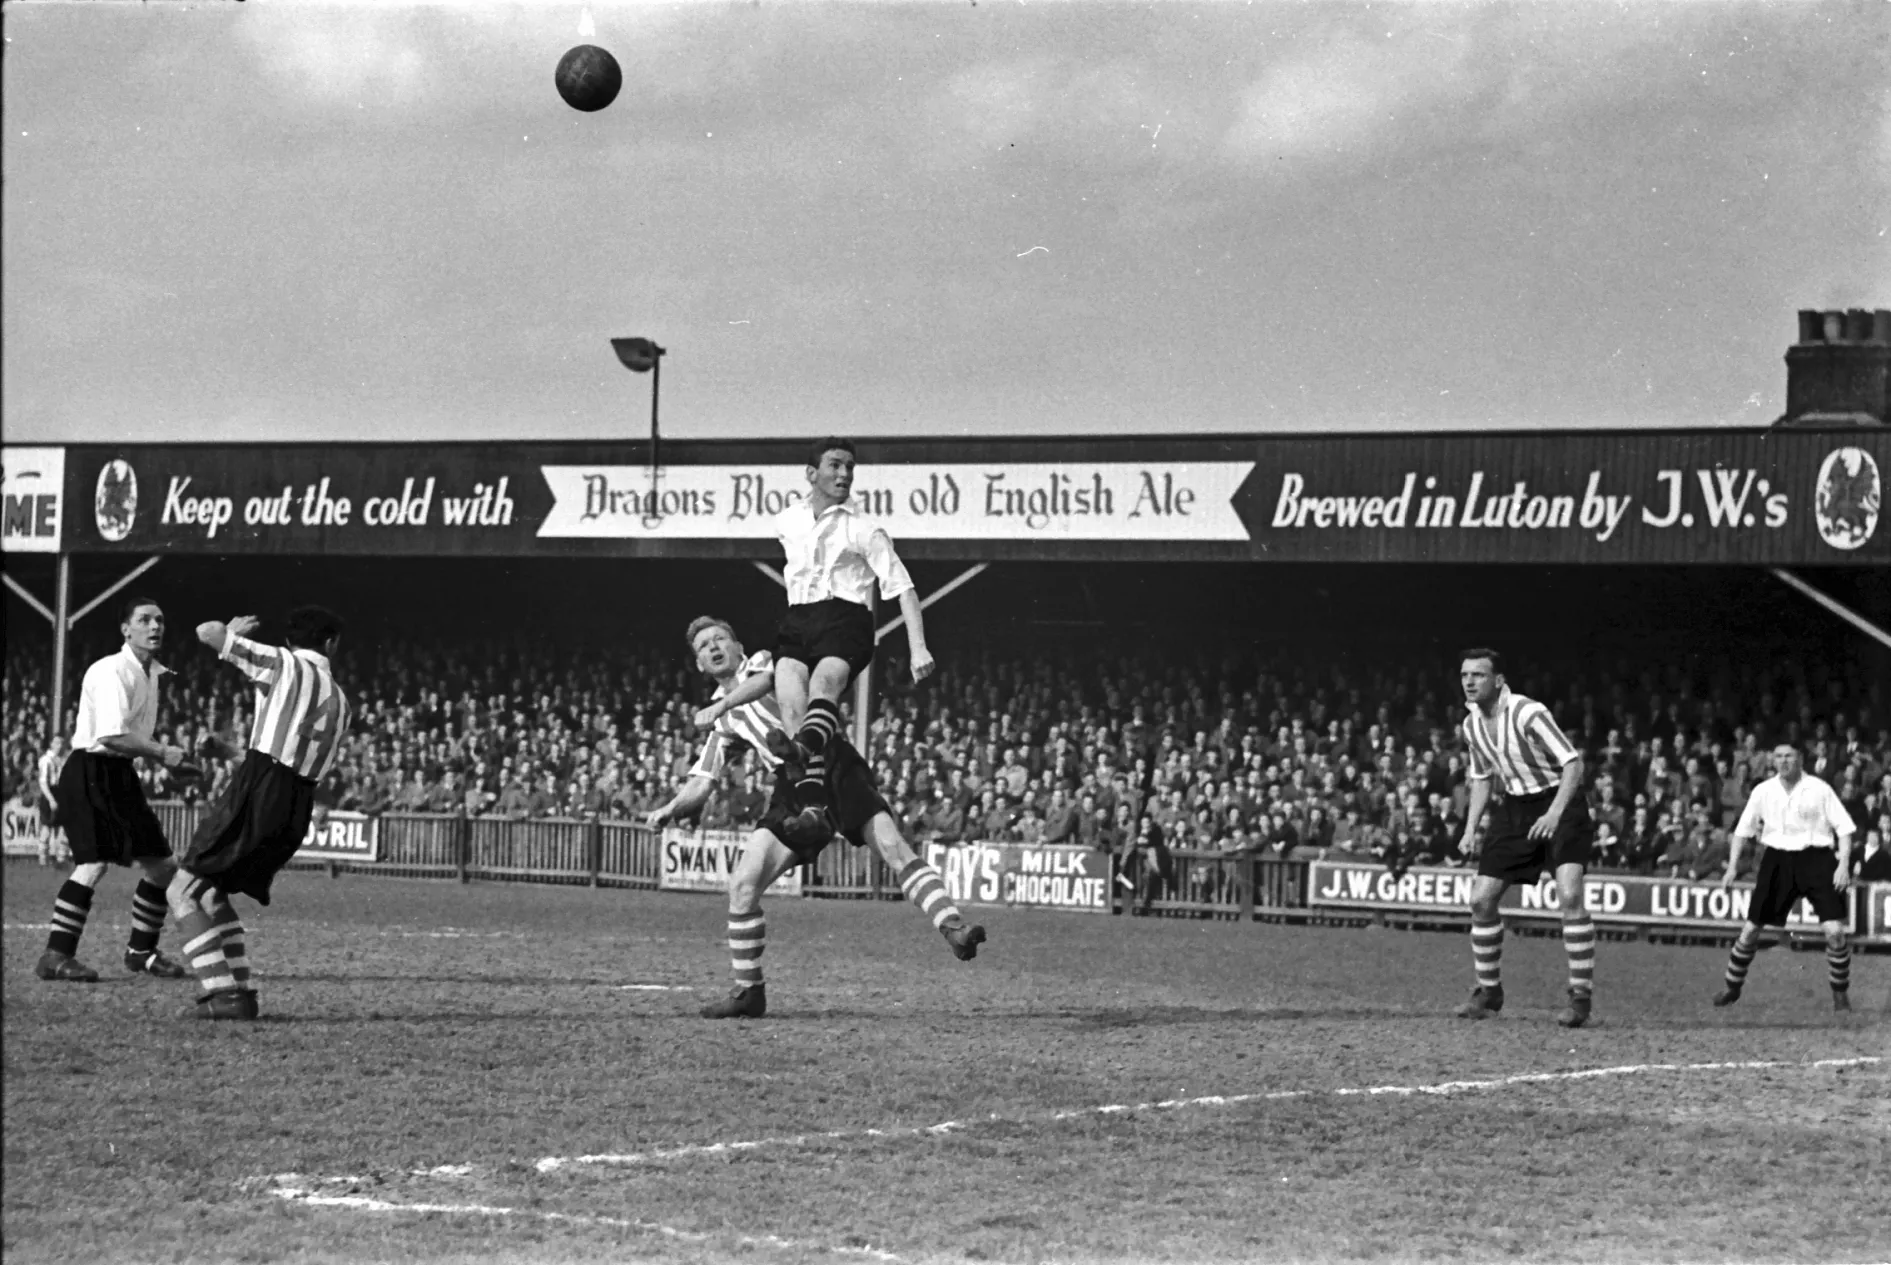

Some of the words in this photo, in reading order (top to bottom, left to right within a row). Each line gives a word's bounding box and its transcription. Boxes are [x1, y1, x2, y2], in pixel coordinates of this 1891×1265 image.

[4, 494, 57, 537] ME
[161, 475, 233, 538] Keep
[244, 485, 292, 525] out
[301, 475, 351, 525] the
[363, 476, 435, 525] cold
[443, 475, 514, 525] with
[580, 473, 716, 530] Dragons
[728, 473, 804, 520] Bloo
[909, 472, 960, 516] old
[984, 471, 1114, 530] English
[1127, 470, 1195, 518] Ale
[1272, 472, 1417, 528] Brewed
[1414, 475, 1456, 528] in
[1459, 470, 1574, 529] Luton
[1579, 470, 1632, 542] by
[5, 811, 37, 841] SWA
[302, 820, 368, 849] VRIL
[666, 841, 717, 874] SWAN
[1021, 850, 1088, 876] MILK
[1003, 872, 1106, 907] CHOCOLATE
[1521, 880, 1626, 912] NOED
[1651, 884, 1751, 920] LUTON
